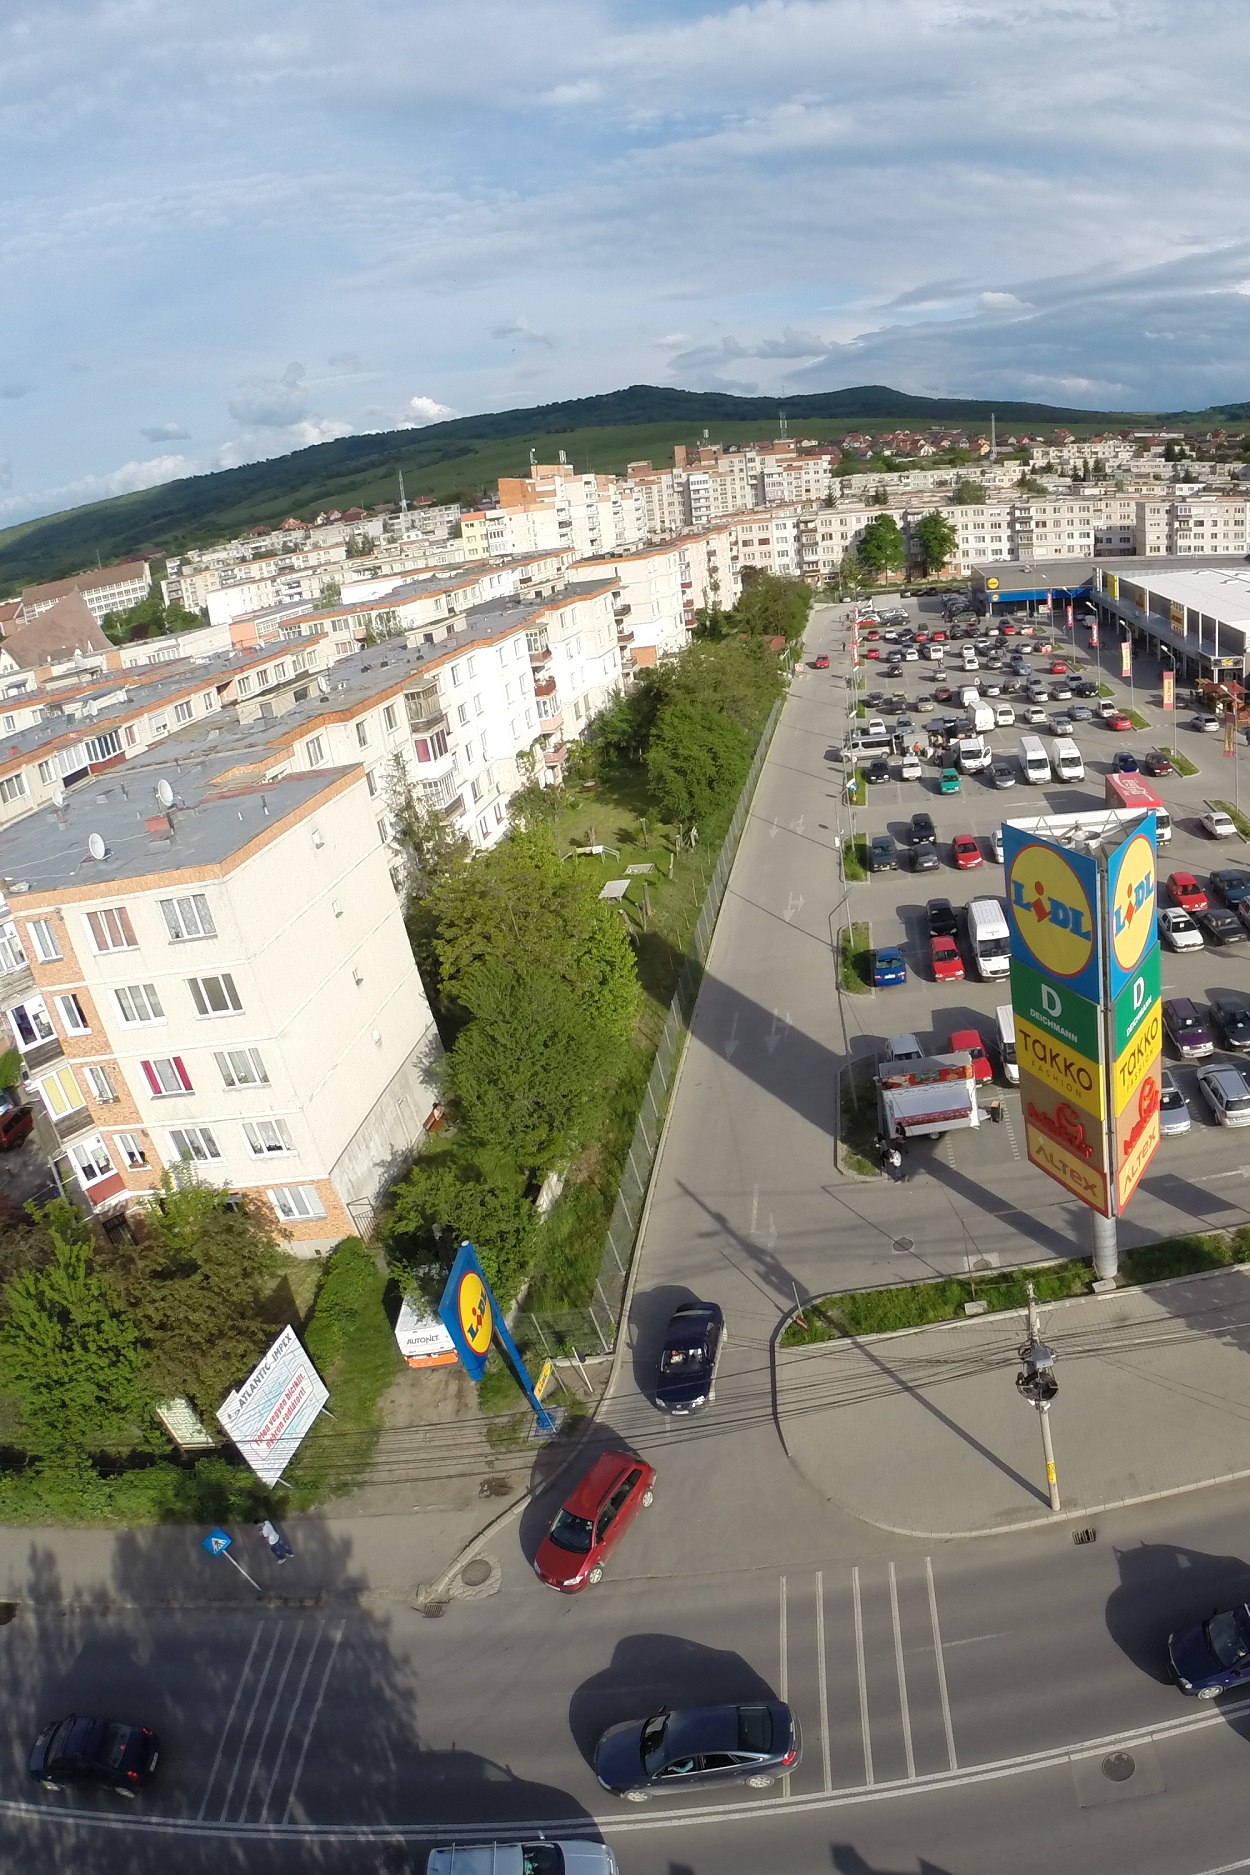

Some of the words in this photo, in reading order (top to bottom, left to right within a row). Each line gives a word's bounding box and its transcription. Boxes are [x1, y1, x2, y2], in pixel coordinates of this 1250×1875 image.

[1041, 983, 1062, 1018] D
[1133, 976, 1144, 1010] D
[1029, 1008, 1078, 1043] DEICHMANN
[1126, 995, 1152, 1037] DEICHMANN
[1031, 1060, 1082, 1098] FASHION
[1126, 1047, 1154, 1092] FASHION
[406, 1334, 441, 1345] AUTONET
[237, 1363, 271, 1409] ATLANTIC
[271, 1332, 293, 1362] IMPEX
